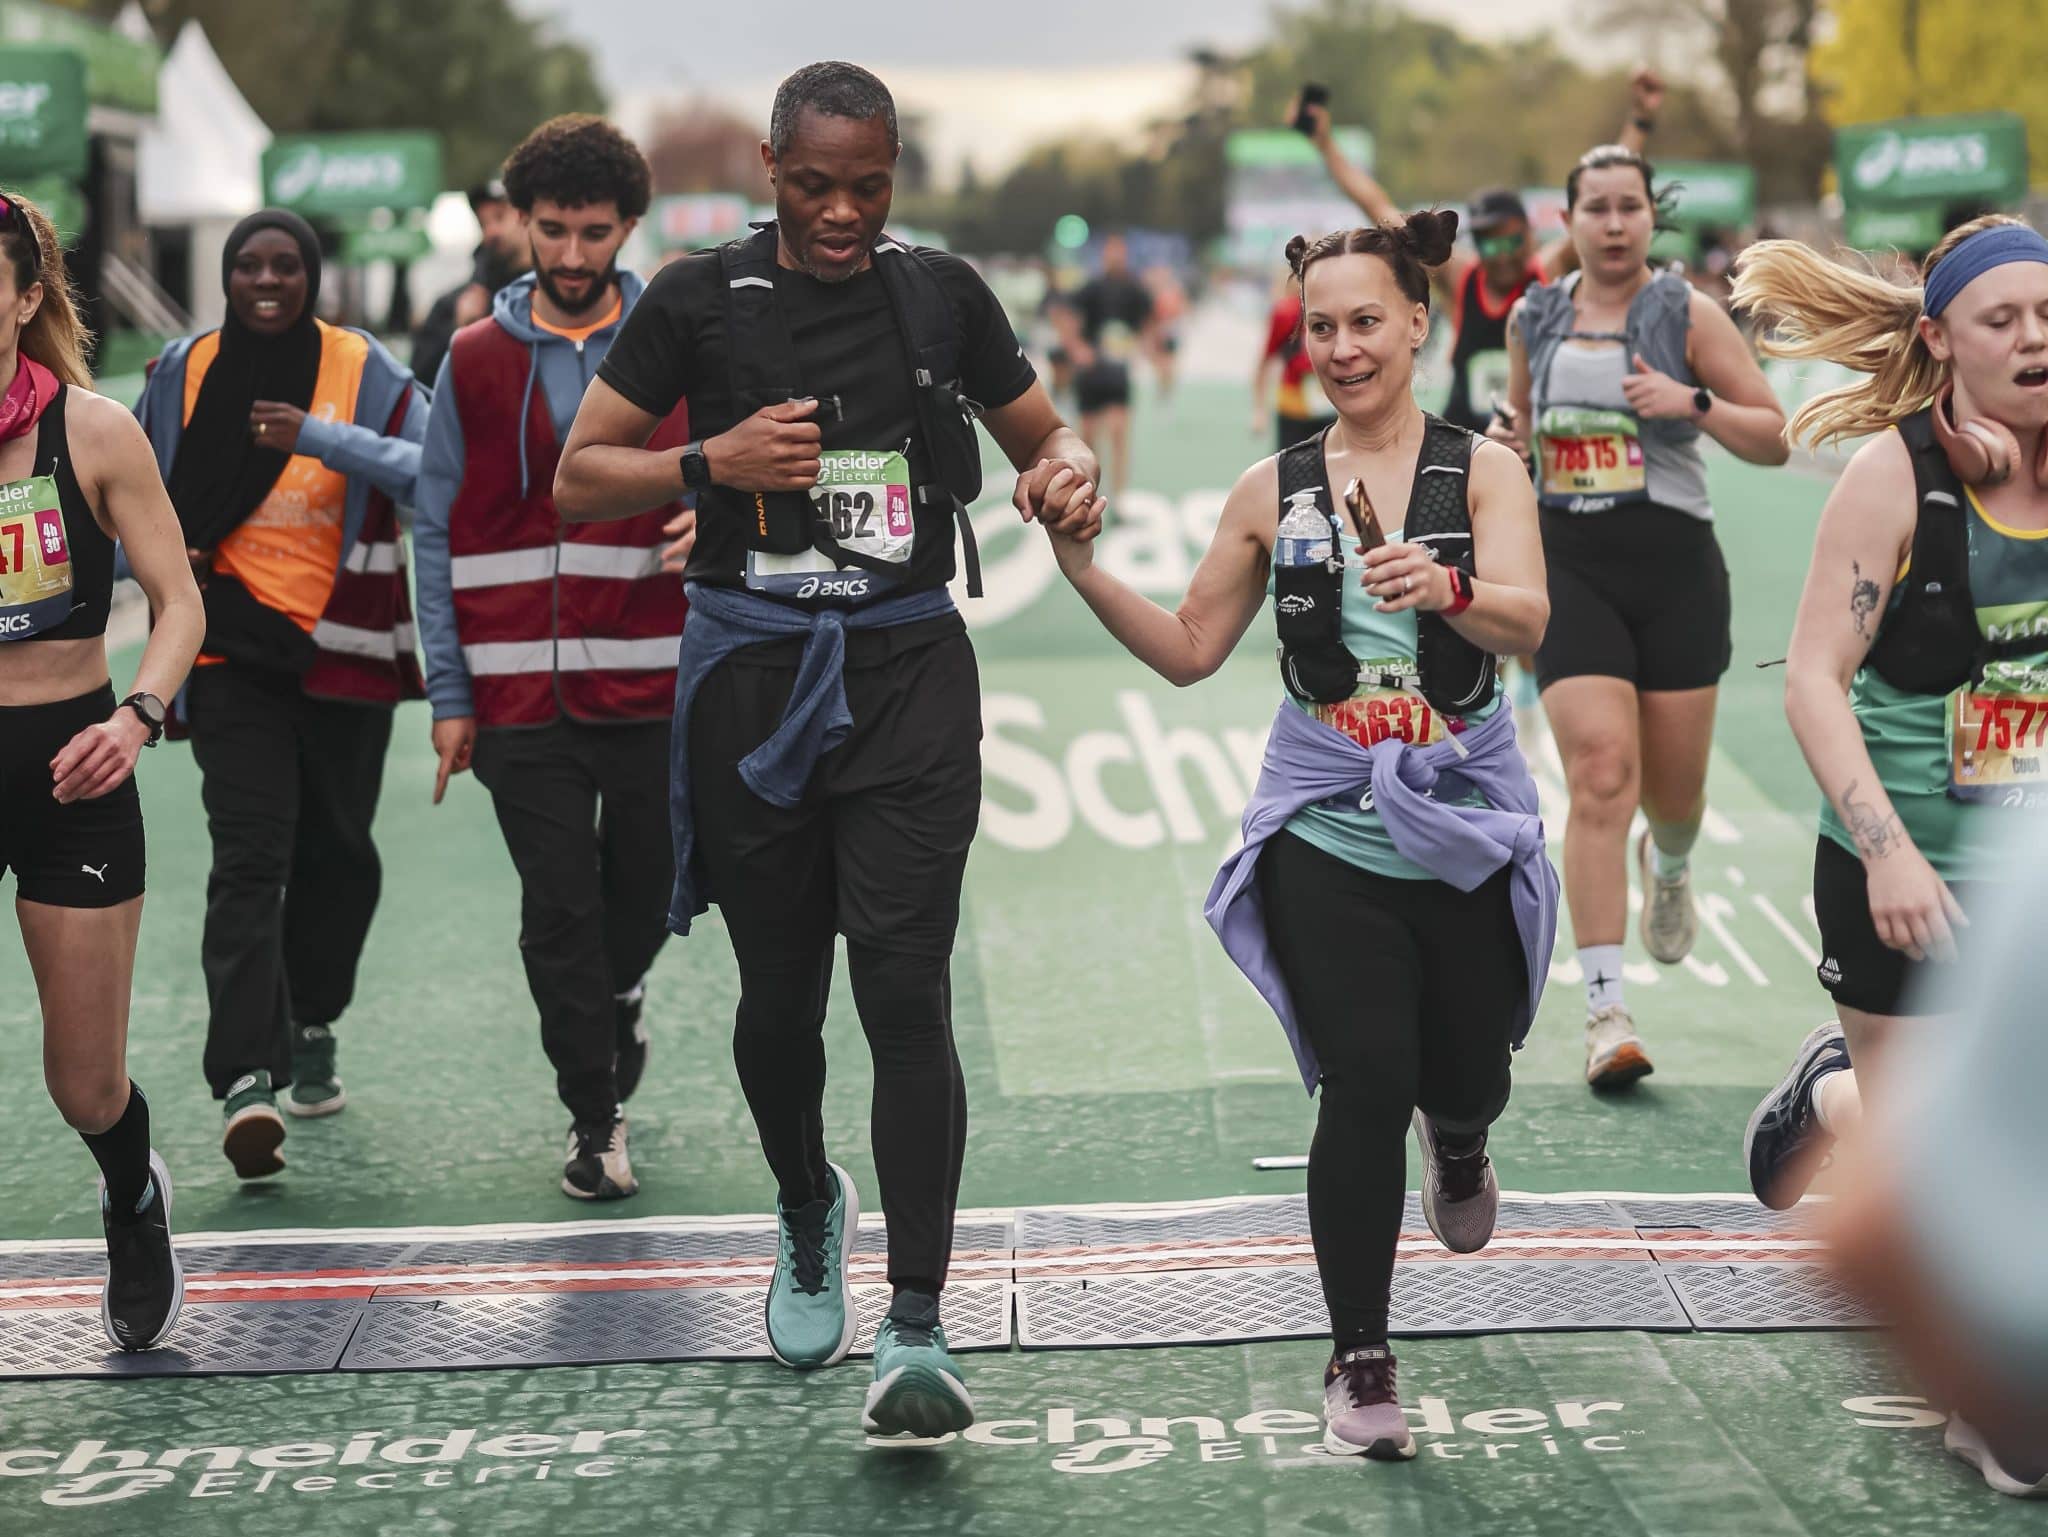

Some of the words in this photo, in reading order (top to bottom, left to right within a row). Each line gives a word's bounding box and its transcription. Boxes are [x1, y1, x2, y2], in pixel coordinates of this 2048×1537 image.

[833, 470, 888, 482] Electric
[891, 496, 906, 512] 4h
[43, 522, 58, 538] 4h
[820, 578, 870, 597] asics
[1974, 699, 2048, 751] 7577
[189, 1459, 616, 1498] Electric
